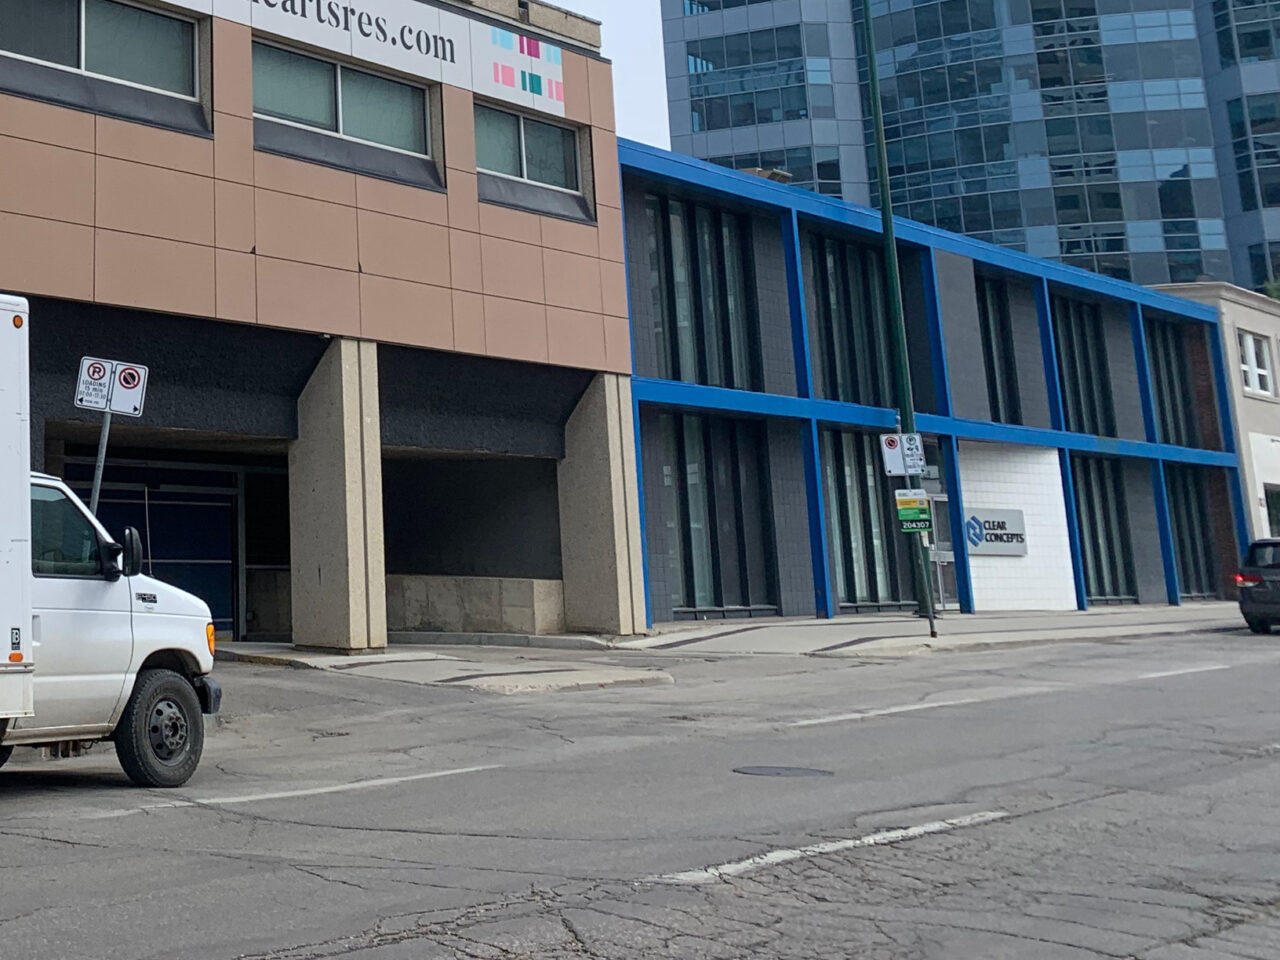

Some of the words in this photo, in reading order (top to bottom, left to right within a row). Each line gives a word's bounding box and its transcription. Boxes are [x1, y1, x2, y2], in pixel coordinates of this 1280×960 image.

[82, 380, 107, 388] LOADING
[983, 520, 1007, 531] CLEAR
[984, 532, 1025, 543] CONCEPTS
